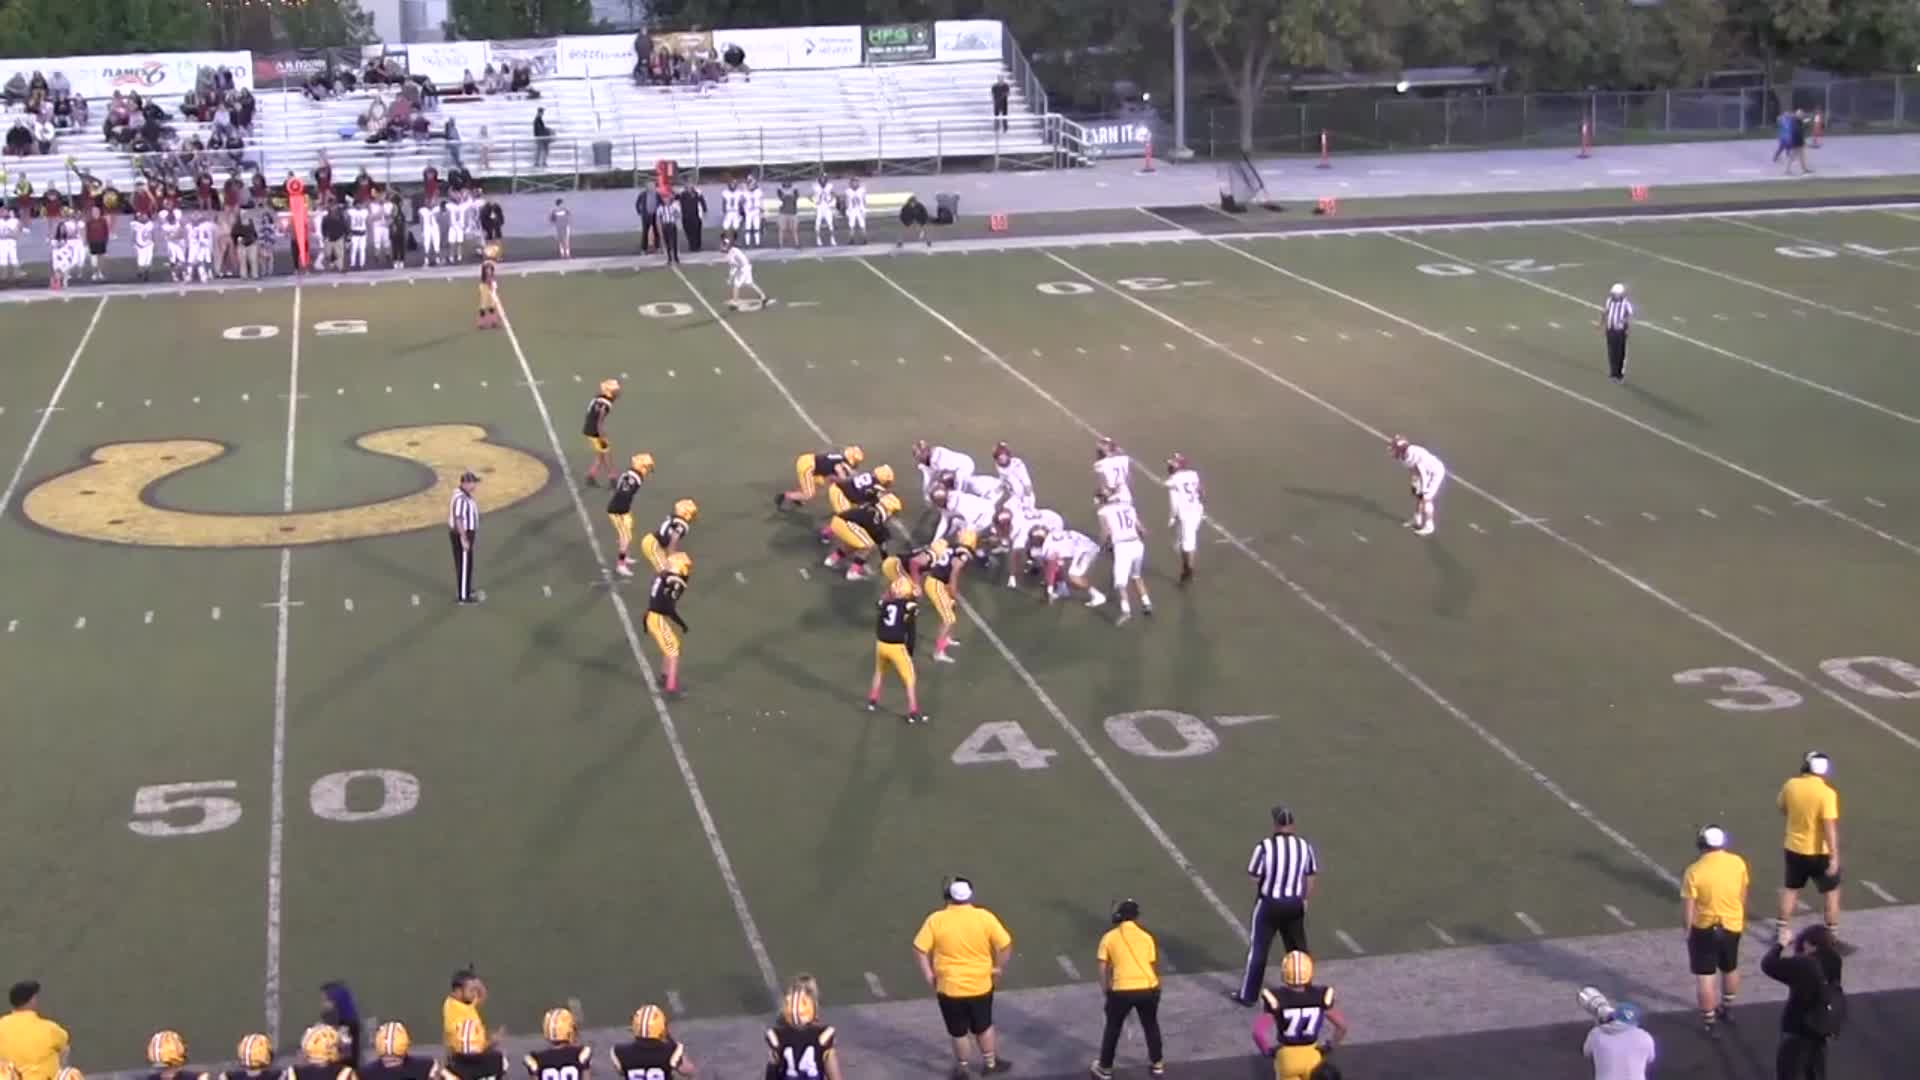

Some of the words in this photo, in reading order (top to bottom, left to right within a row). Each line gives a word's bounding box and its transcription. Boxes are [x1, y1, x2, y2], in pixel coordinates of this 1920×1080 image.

[1116, 509, 1134, 530] 16
[883, 603, 898, 626] 3
[1283, 1006, 1320, 1037] 77
[783, 1045, 819, 1077] 14
